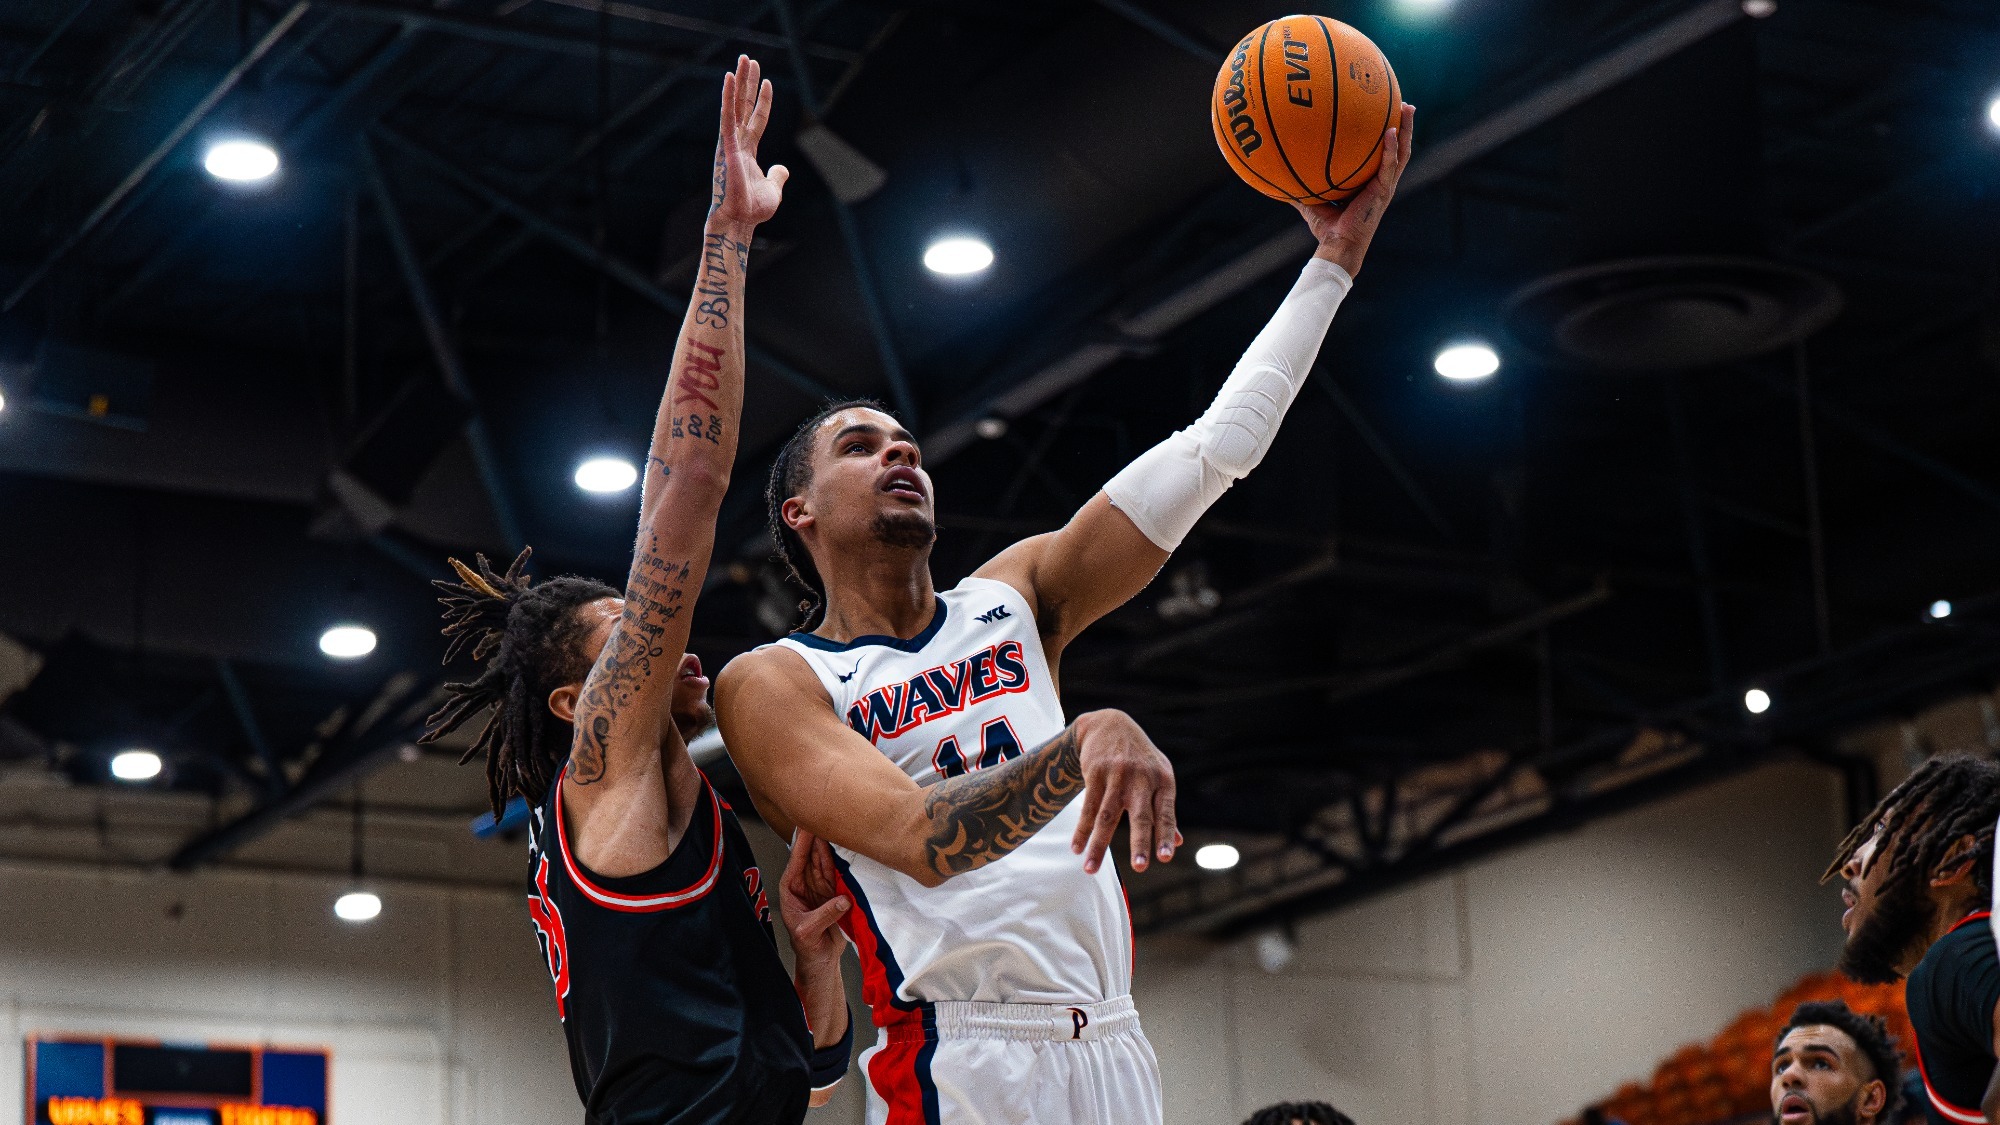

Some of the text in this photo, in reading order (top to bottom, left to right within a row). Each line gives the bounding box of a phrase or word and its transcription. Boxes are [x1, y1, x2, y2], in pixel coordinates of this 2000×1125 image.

[1283, 39, 1313, 109] EVO
[1223, 32, 1264, 159] Wilson
[695, 232, 736, 330] Blizzy
[672, 417, 685, 438] BE
[688, 414, 703, 439] DO
[705, 414, 723, 445] FOR
[974, 604, 1012, 625] WCC
[847, 640, 1030, 748] WAVES
[1066, 1007, 1088, 1040] P
